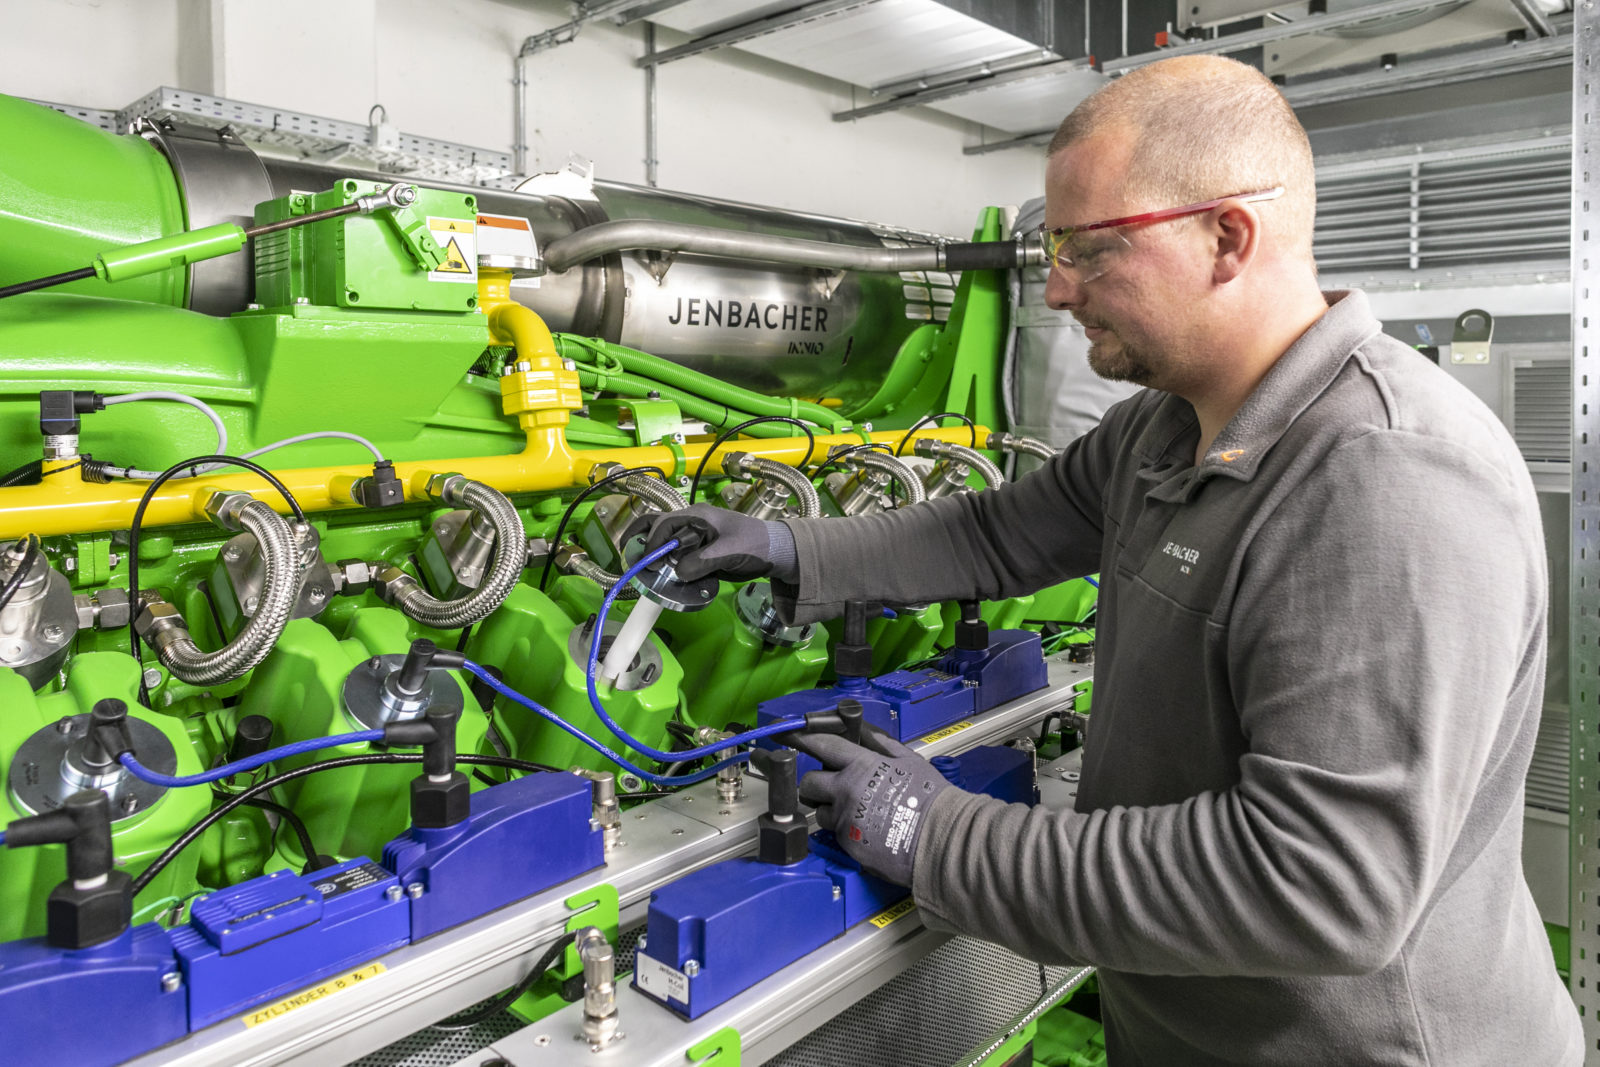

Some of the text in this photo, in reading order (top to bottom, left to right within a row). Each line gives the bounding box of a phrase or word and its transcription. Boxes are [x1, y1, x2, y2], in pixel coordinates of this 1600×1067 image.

[668, 297, 828, 332] JENBACHER
[1163, 541, 1200, 565] JEBACHER
[253, 987, 329, 1024] ZYLINDER
[335, 980, 346, 989] 8
[369, 965, 379, 974] 7
